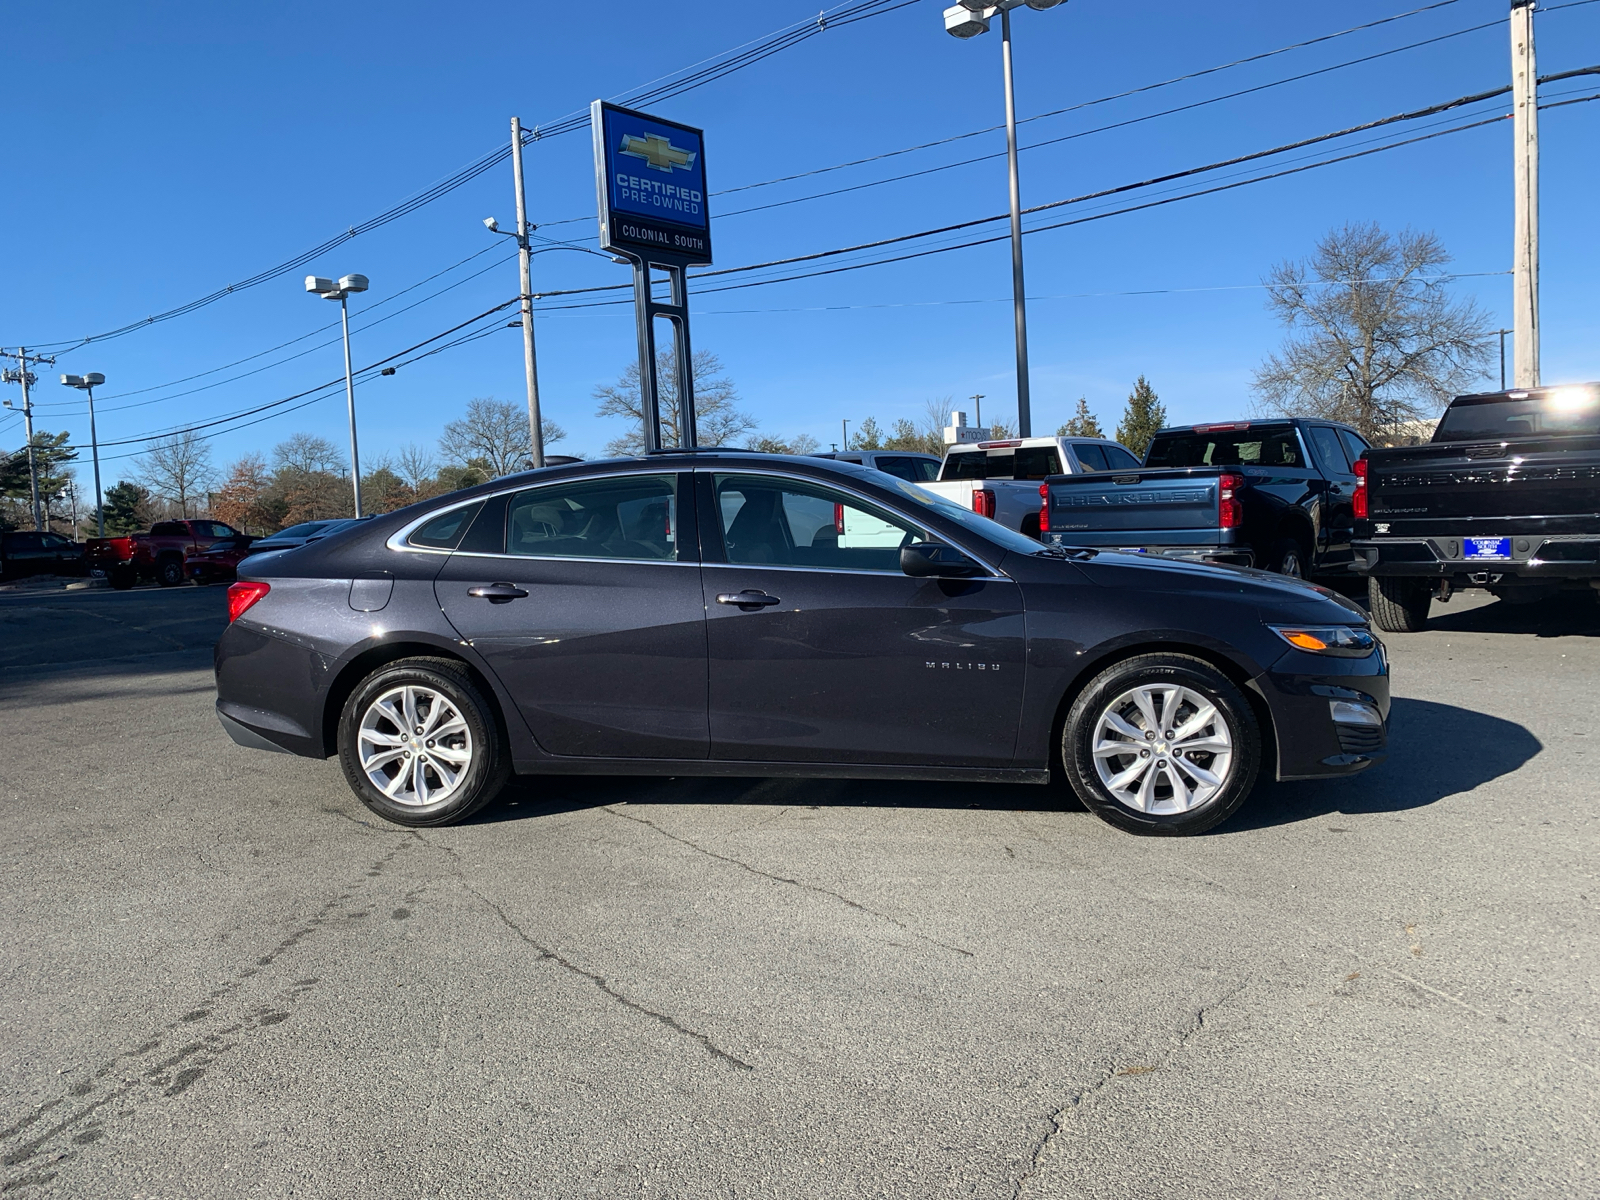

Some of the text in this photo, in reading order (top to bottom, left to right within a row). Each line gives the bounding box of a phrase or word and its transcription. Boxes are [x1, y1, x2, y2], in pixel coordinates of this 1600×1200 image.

[616, 173, 702, 203] CERTIFIED
[622, 188, 699, 215] PRE-OWNED
[622, 224, 704, 250] COLONIAL SOUTH
[1056, 491, 1206, 506] CHEVROLET
[925, 661, 1001, 671] MALIBU
